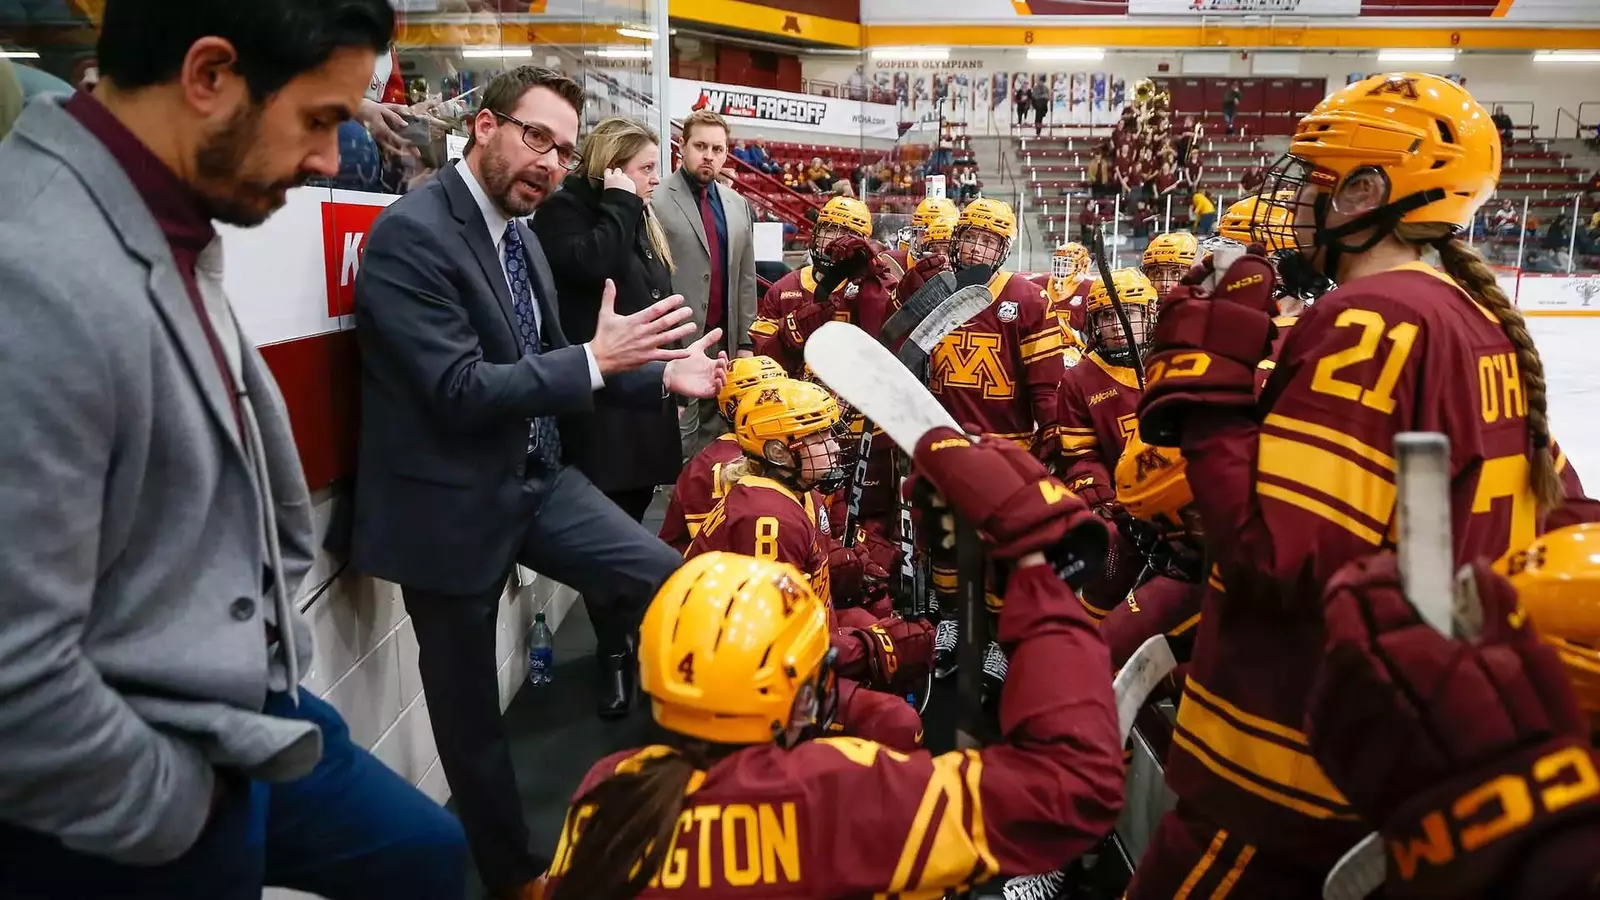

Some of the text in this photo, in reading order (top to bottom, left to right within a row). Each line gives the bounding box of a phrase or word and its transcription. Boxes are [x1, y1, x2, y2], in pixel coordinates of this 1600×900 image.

[1024, 31, 1034, 44] 8
[1451, 32, 1460, 46] 9
[876, 60, 984, 69] GOPHER OLYMPIANS
[726, 93, 756, 109] FINAL
[756, 96, 826, 125] FACEOFF
[831, 211, 851, 219] CCM
[1311, 308, 1419, 415] 21
[1478, 353, 1530, 423] O'H
[850, 431, 873, 517] CCM
[754, 516, 779, 561] 8
[677, 652, 695, 684] 4
[1390, 746, 1600, 880] CCM
